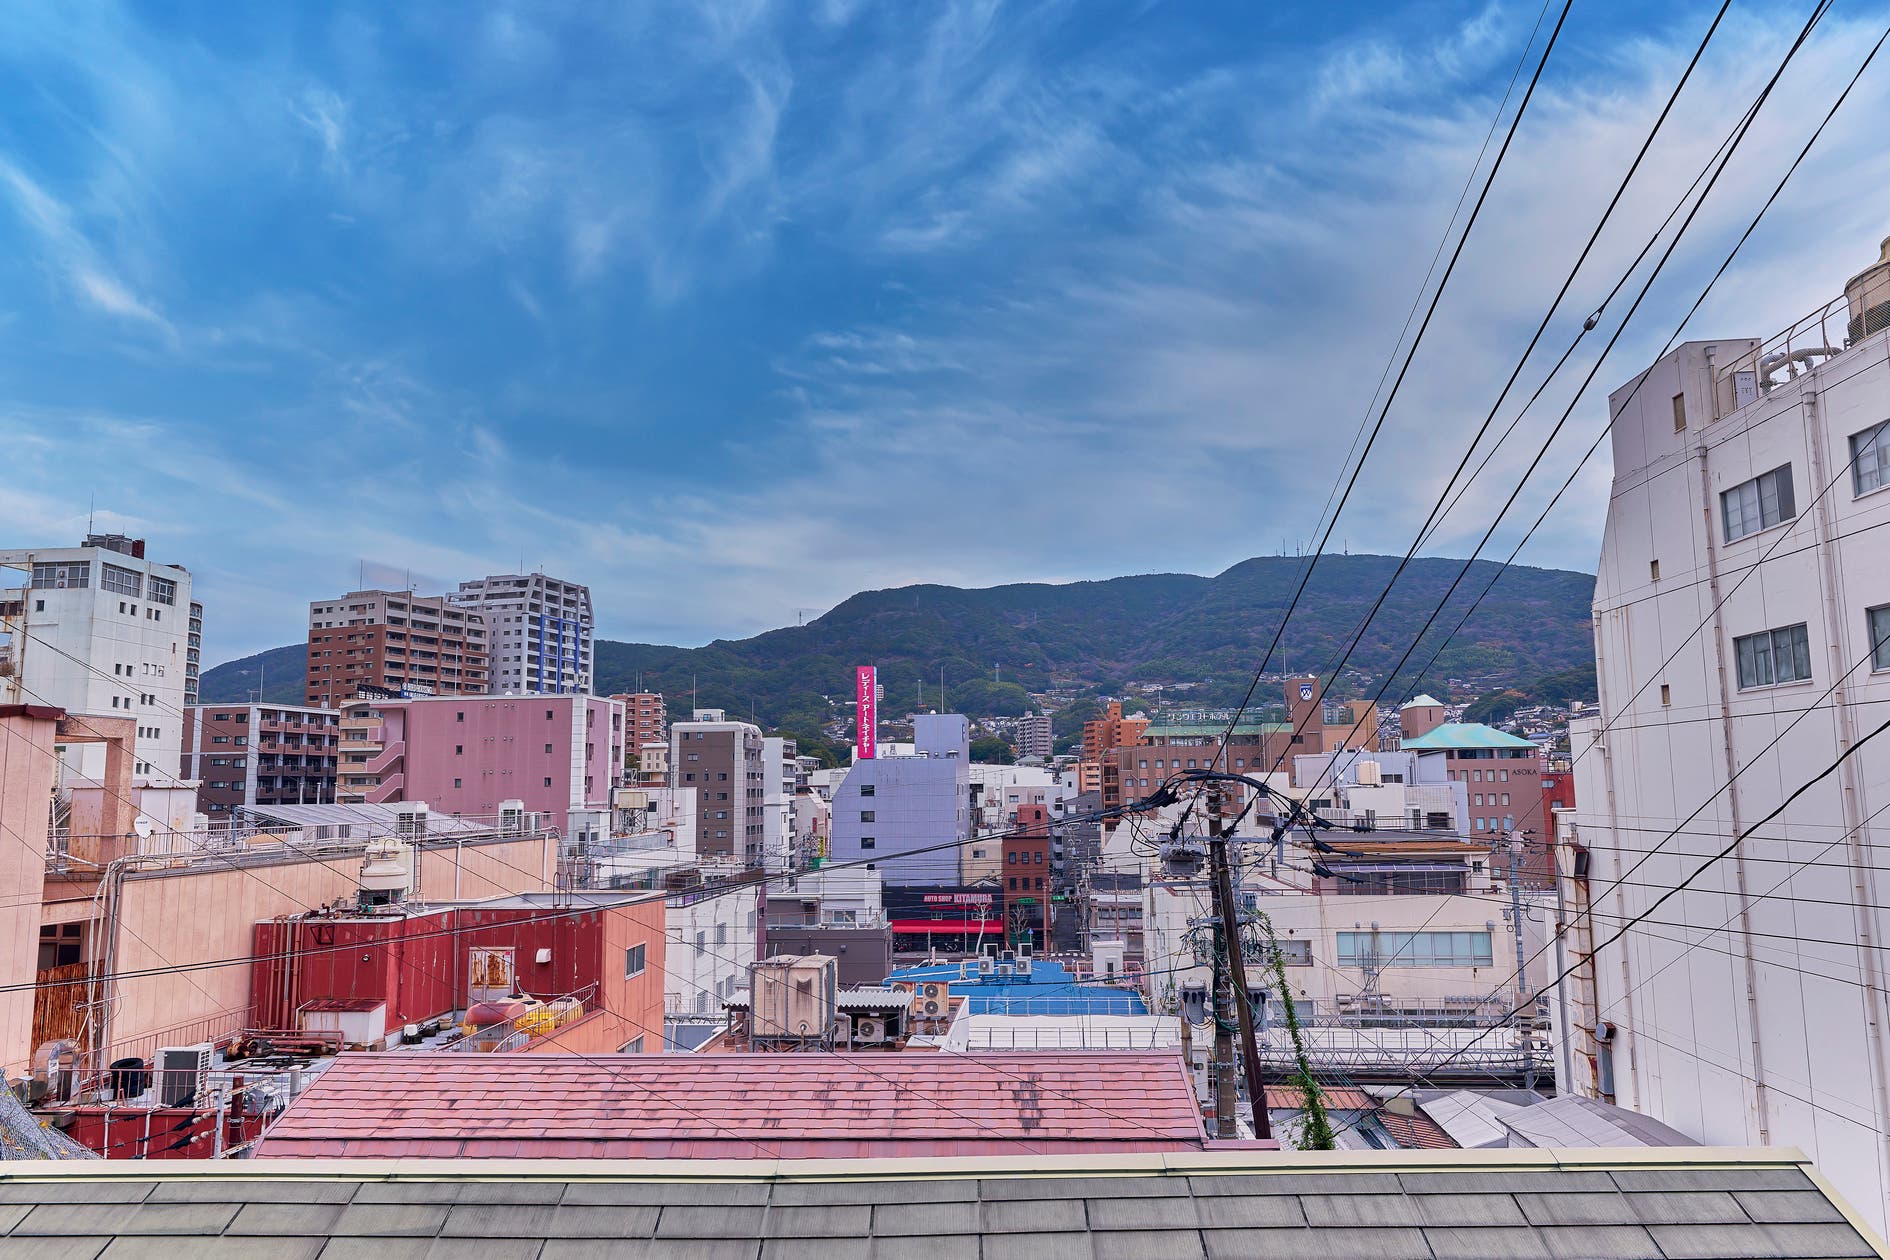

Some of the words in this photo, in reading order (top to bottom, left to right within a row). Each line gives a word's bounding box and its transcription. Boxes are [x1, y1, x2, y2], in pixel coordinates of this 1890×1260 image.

[861, 672, 870, 702] レディース
[862, 704, 870, 753] アートネイチャー
[1511, 768, 1537, 776] ASOKA
[954, 893, 993, 902] KITAMURA
